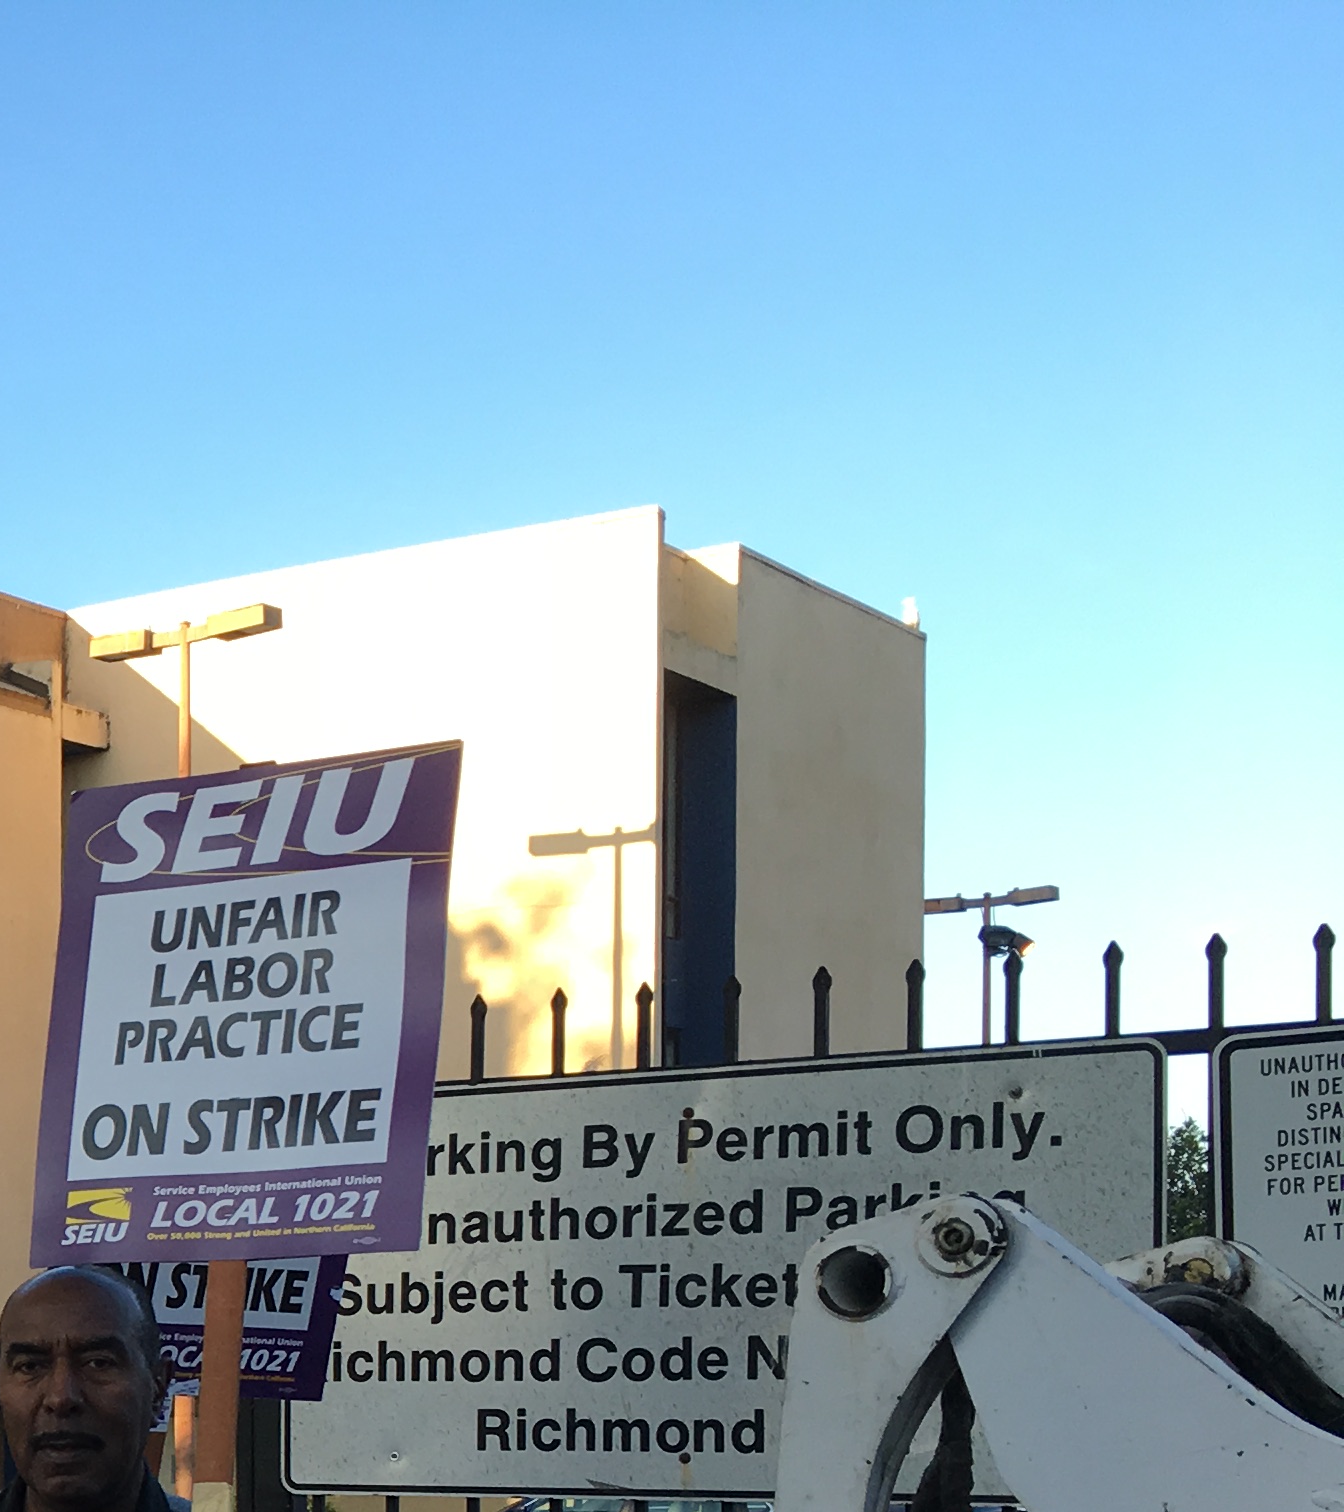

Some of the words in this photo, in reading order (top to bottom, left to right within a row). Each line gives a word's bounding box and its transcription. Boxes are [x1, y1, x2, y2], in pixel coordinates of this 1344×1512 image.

[100, 757, 416, 883] SEIU
[150, 890, 341, 953] UNFAIR
[150, 948, 334, 1007] LABOR
[115, 1002, 364, 1066] PRACTICE
[1291, 1079, 1310, 1098] IN
[1318, 1076, 1343, 1096] DE
[82, 1101, 171, 1161] ON
[183, 1087, 381, 1156] STRIKE
[1306, 1101, 1344, 1121] SPA
[427, 1130, 562, 1183] rking
[582, 1124, 656, 1179] By
[676, 1110, 873, 1164] Permit
[895, 1101, 1063, 1161] Only.
[1277, 1125, 1342, 1148] DISTIN
[1264, 1149, 1344, 1173] SPECIAL
[153, 1186, 195, 1197] Service
[198, 1183, 262, 1197] Employees
[265, 1176, 342, 1192] International
[344, 1174, 382, 1187] Union
[1267, 1176, 1306, 1197] FOR
[150, 1196, 280, 1228] LOCAL
[293, 1189, 380, 1222] 1021
[427, 1188, 764, 1245] nauthorized
[61, 1222, 130, 1247] SEIU
[146, 1232, 169, 1241] Over
[204, 1230, 232, 1241] Strong
[234, 1230, 251, 1239] and
[253, 1227, 282, 1238] United
[283, 1227, 292, 1235] in
[293, 1225, 332, 1235] Northern
[333, 1222, 376, 1233] California
[1303, 1223, 1326, 1242] AT
[166, 1263, 310, 1315] STIKE
[337, 1269, 529, 1324] Subject
[551, 1268, 604, 1311] to
[619, 1263, 798, 1309] Ticket
[239, 1347, 301, 1373] 1021
[277, 1336, 304, 1348] Union
[332, 1338, 561, 1382] ichmond
[576, 1335, 729, 1381] Code
[476, 1408, 765, 1454] Richmond
